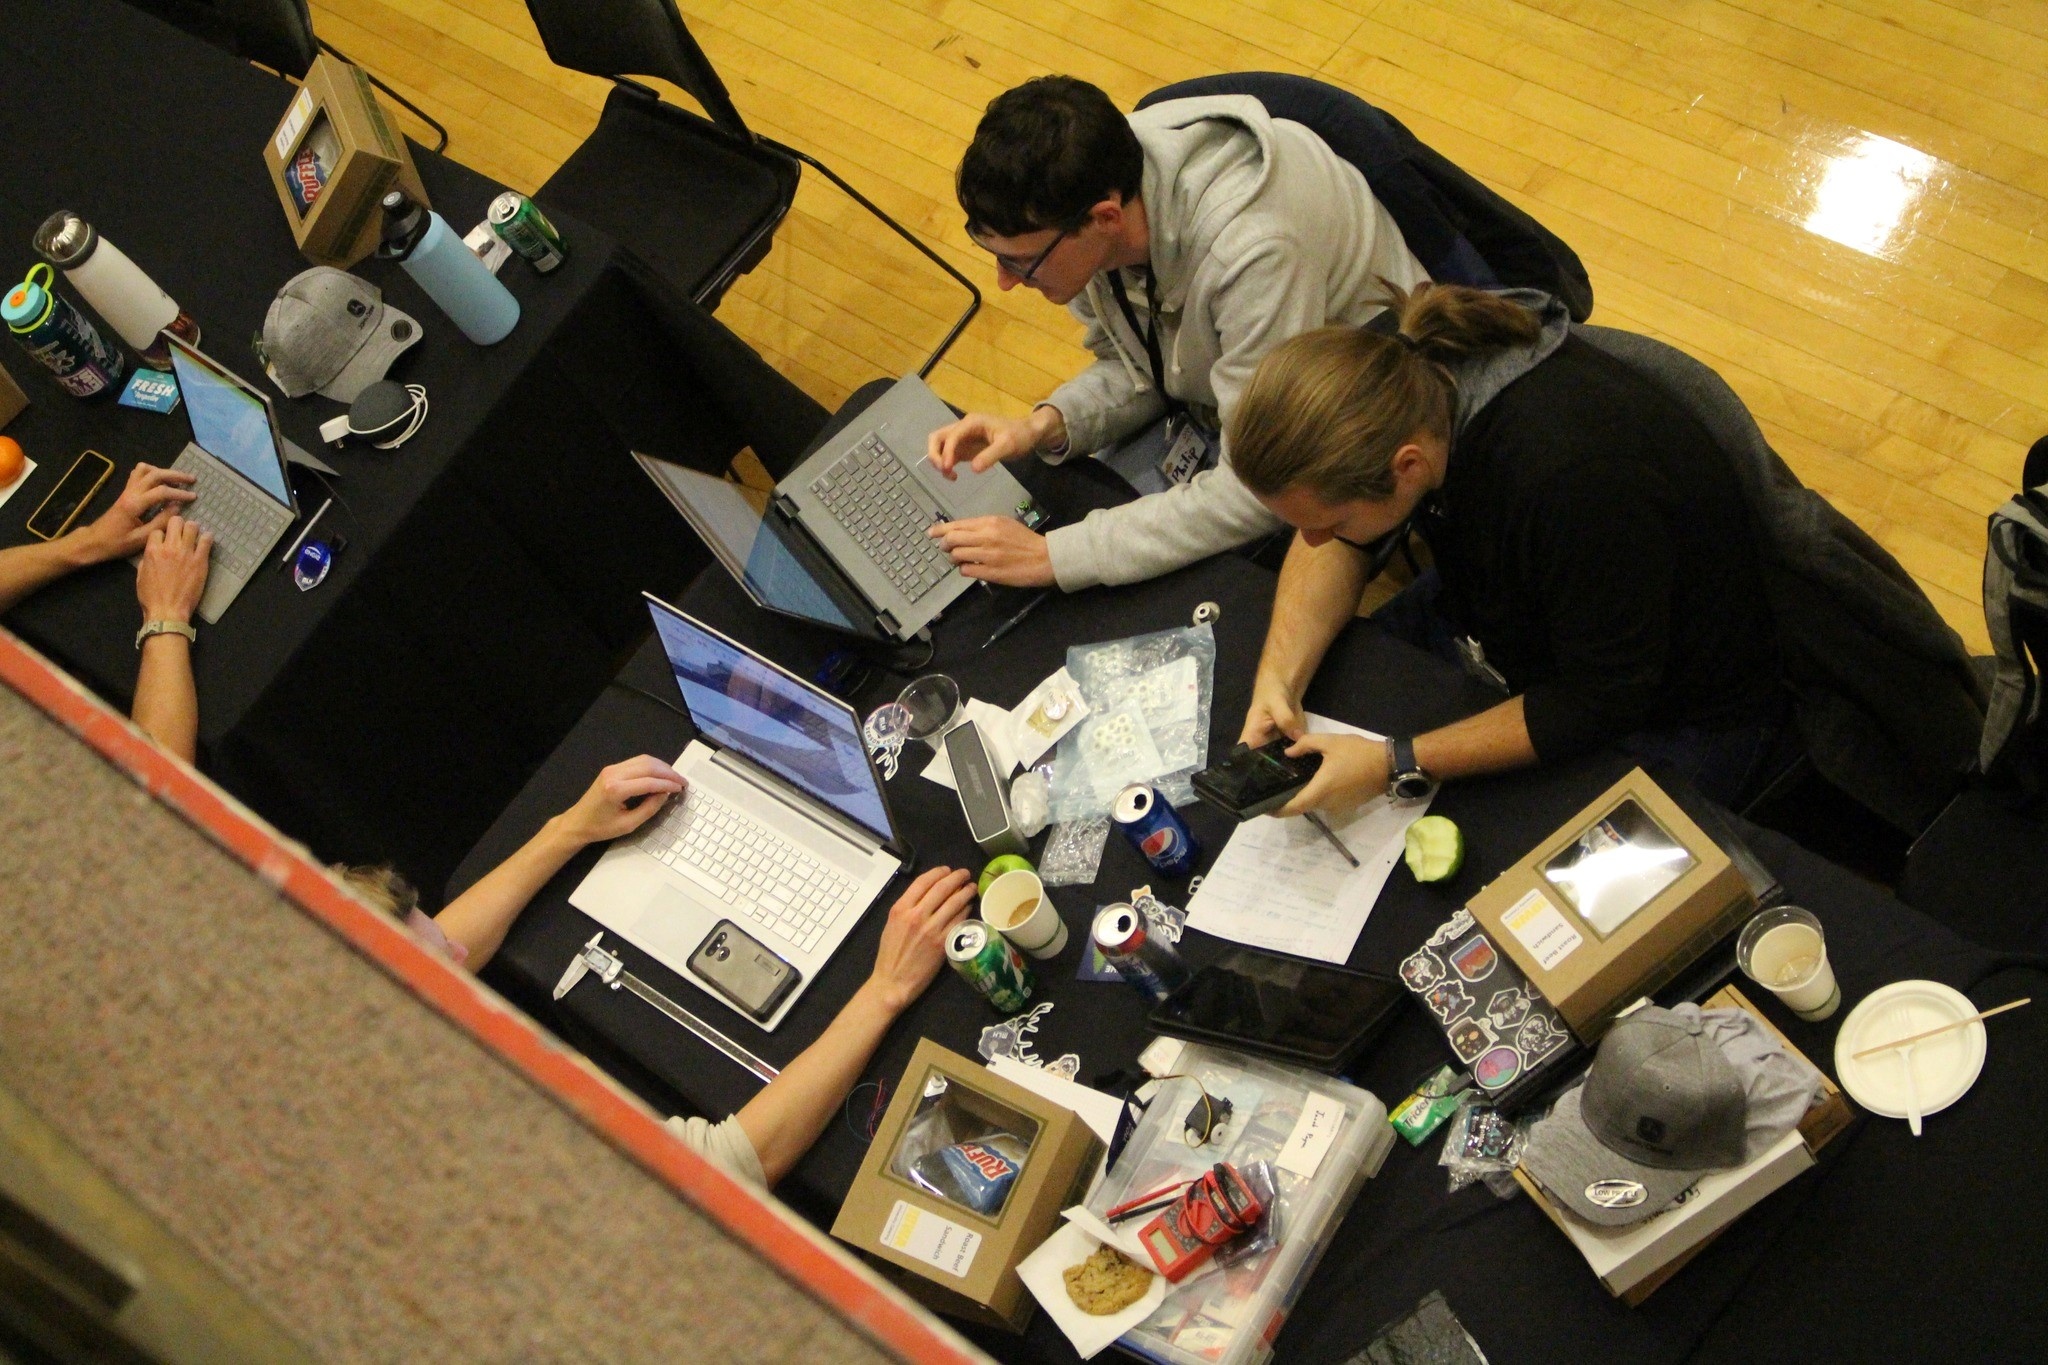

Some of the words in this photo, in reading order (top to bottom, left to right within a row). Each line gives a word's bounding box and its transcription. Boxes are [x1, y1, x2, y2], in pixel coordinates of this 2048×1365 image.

[297, 148, 322, 203] RUFFLE
[131, 378, 176, 397] FRESH
[1171, 446, 1199, 483] Philip
[1533, 922, 1564, 949] Sandwich
[1558, 934, 1577, 951] Roast
[1542, 949, 1559, 964] Beef
[1403, 1090, 1433, 1129] Trident
[958, 1144, 1013, 1181] RUFF
[932, 1224, 952, 1261] Sandwich
[959, 1232, 973, 1253] Roast
[951, 1253, 964, 1272] Beef
